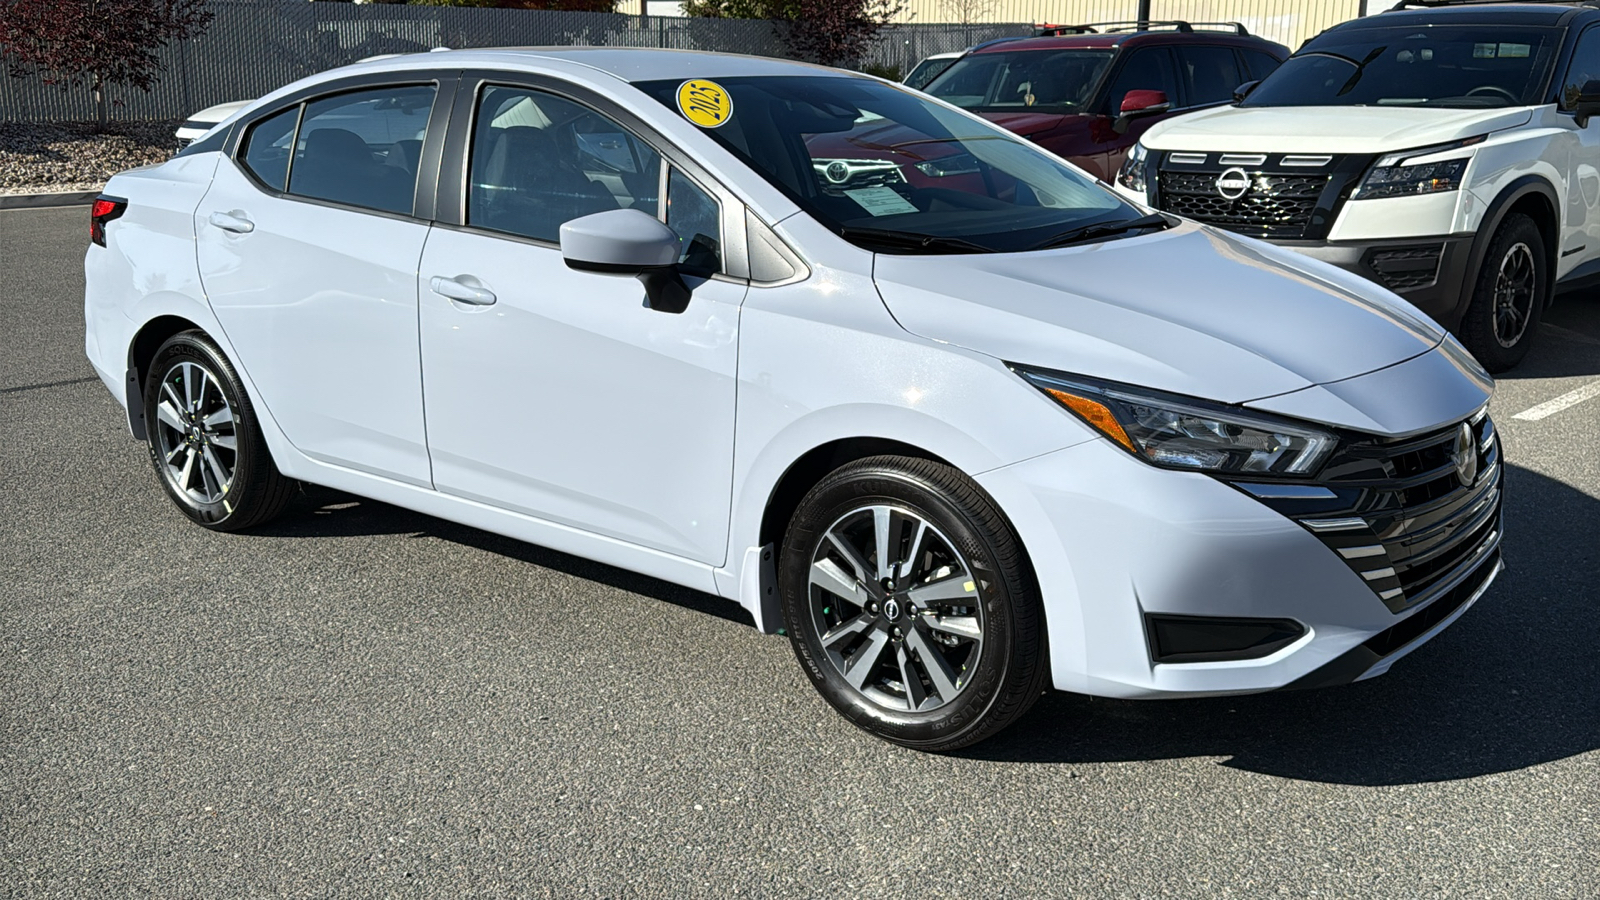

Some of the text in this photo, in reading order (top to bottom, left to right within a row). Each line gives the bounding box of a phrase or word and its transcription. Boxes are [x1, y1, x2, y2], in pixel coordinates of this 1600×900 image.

[689, 83, 721, 121] 2025
[168, 345, 200, 357] SOLUS
[798, 642, 824, 680] 205/55
[950, 666, 996, 727] SOLUS
